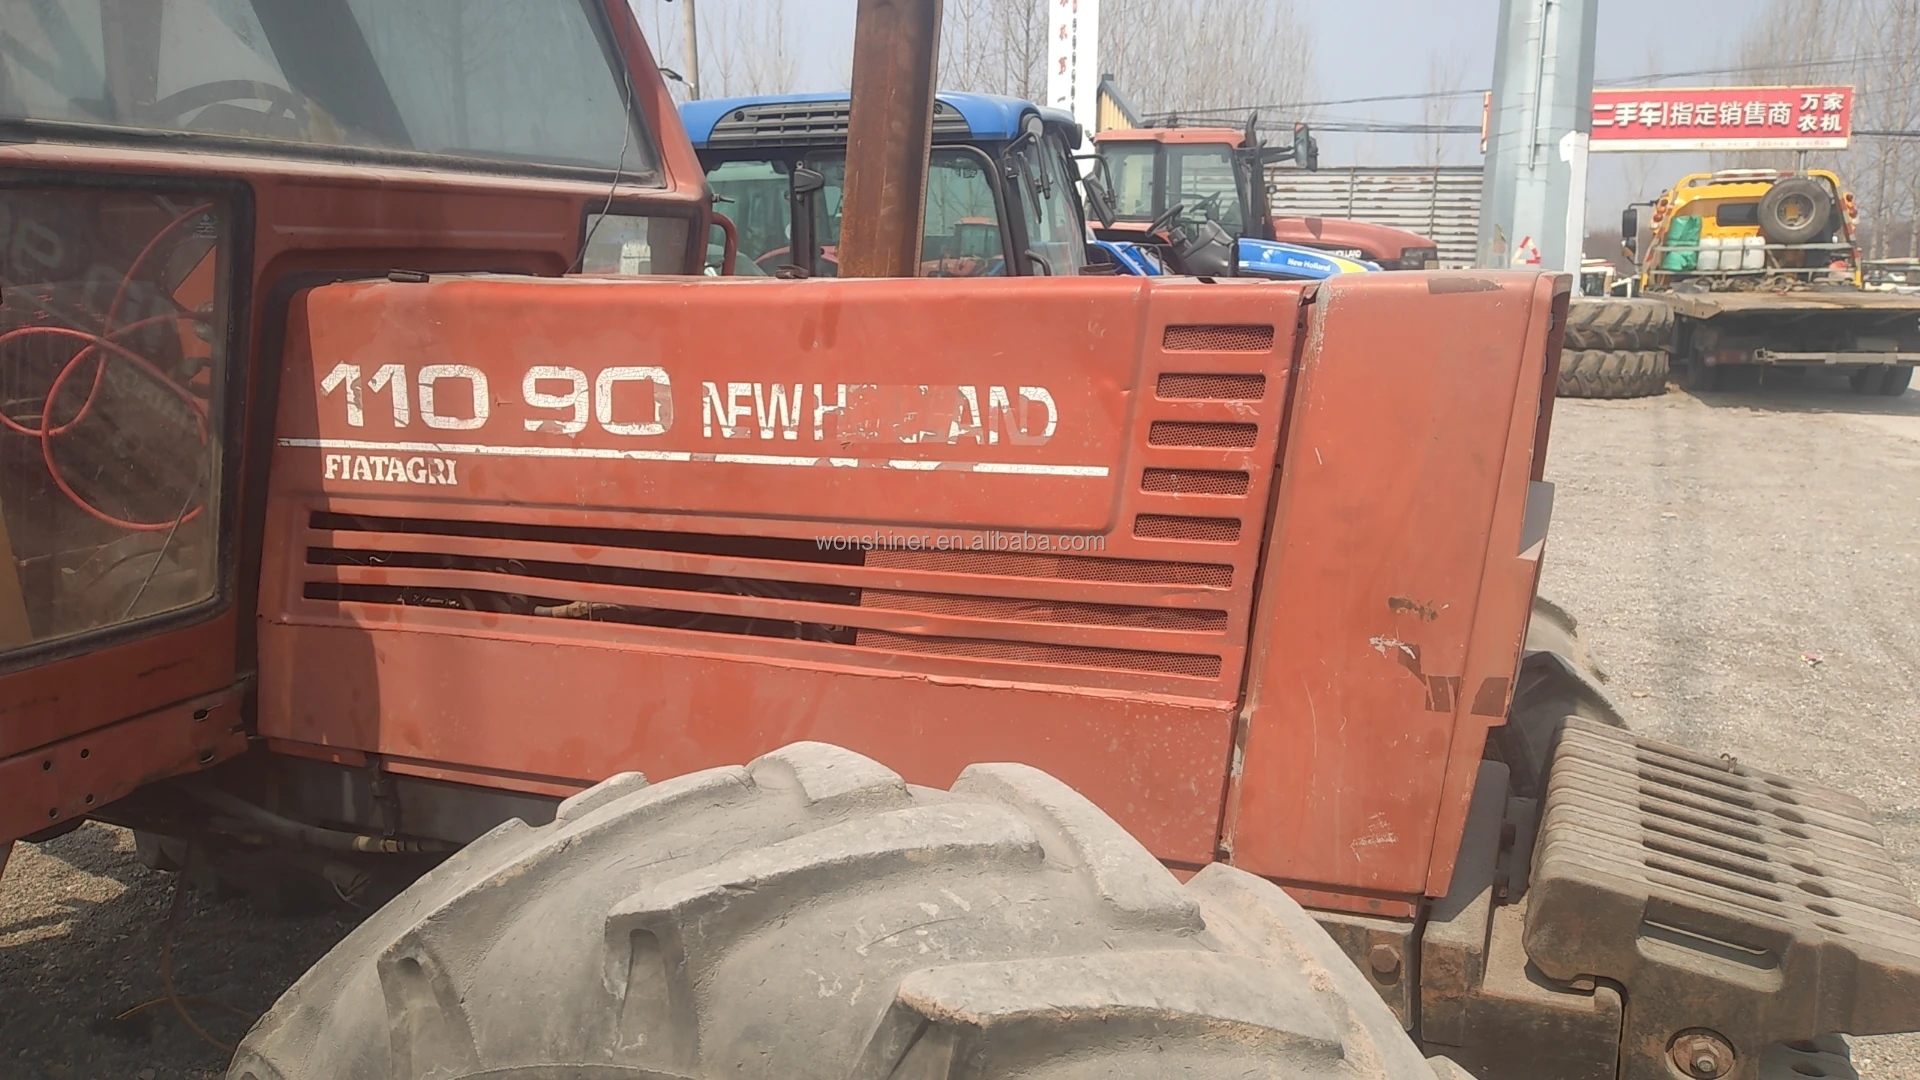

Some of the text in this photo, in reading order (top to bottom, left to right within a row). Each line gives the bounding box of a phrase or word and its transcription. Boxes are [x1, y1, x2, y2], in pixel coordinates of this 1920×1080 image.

[1800, 92, 1844, 111] 万家
[1797, 113, 1843, 132] 农机
[1287, 258, 1331, 271] New Holland
[319, 360, 674, 436] 110 90
[702, 381, 1058, 446] NEW HAND
[324, 454, 458, 486] FIATAGRI
